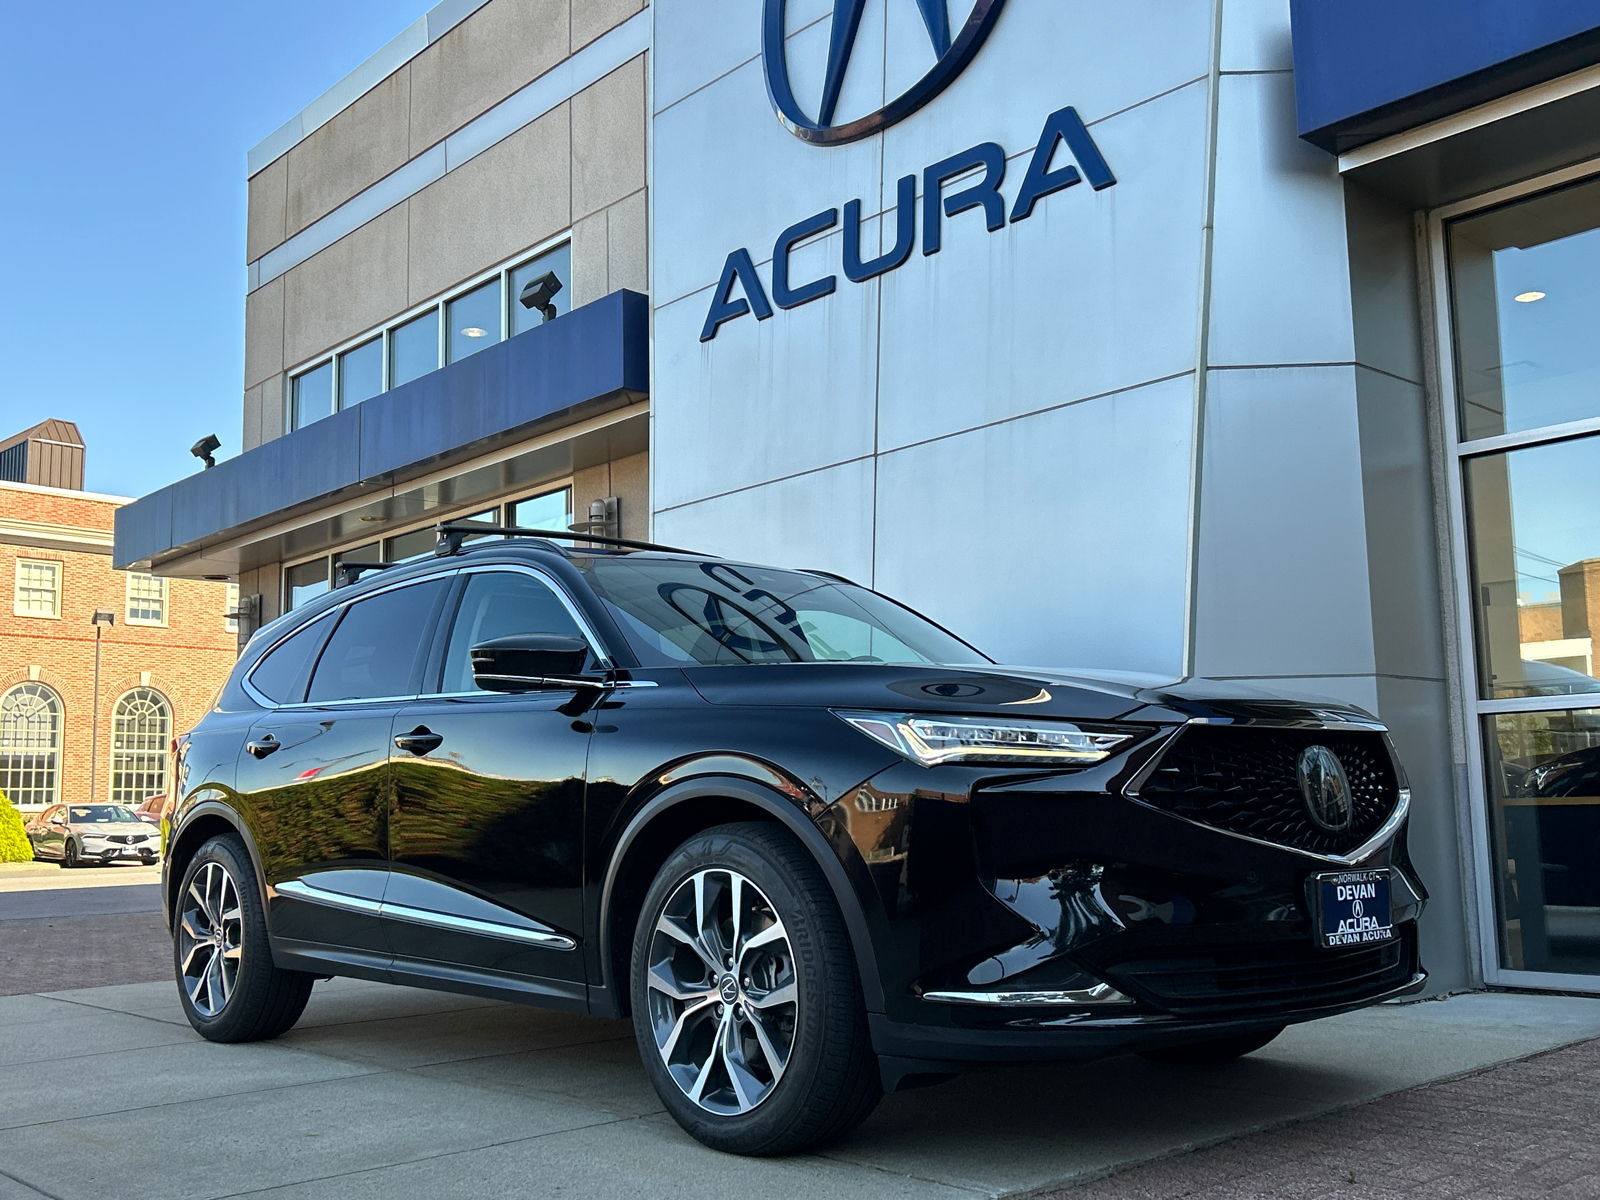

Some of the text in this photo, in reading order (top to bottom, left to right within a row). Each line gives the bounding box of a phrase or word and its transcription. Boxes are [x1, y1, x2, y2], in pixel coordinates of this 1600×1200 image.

[699, 105, 1117, 343] ACURA
[1337, 883, 1376, 901] DEVAN
[1338, 916, 1379, 933] ACURA
[1328, 929, 1392, 946] DEVAN ACURA
